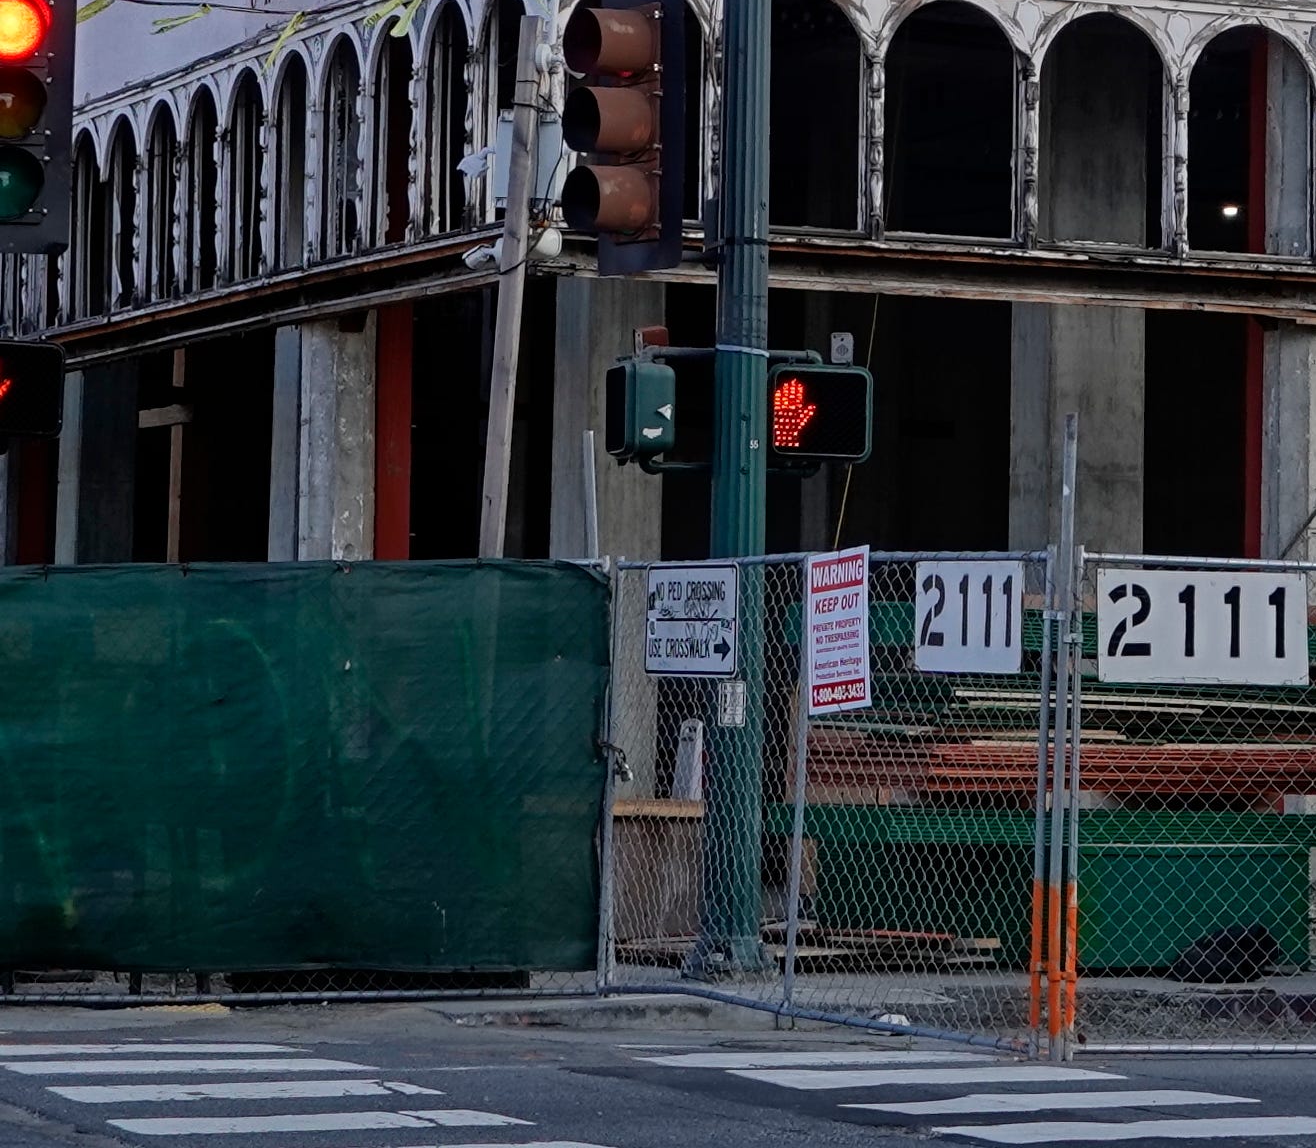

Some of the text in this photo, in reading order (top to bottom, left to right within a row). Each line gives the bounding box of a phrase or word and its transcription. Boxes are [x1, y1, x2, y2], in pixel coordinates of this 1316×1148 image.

[812, 559, 864, 588] WARNING
[656, 580, 726, 602] NO PED CROSSING
[815, 592, 860, 614] KEEP OUT
[921, 574, 1013, 648] 2111
[813, 618, 861, 632] PRIVATE PROPERTY
[1107, 583, 1286, 658] 2111
[648, 638, 710, 659] USE CROSSWALK
[816, 630, 859, 645] NO TRESPASSING
